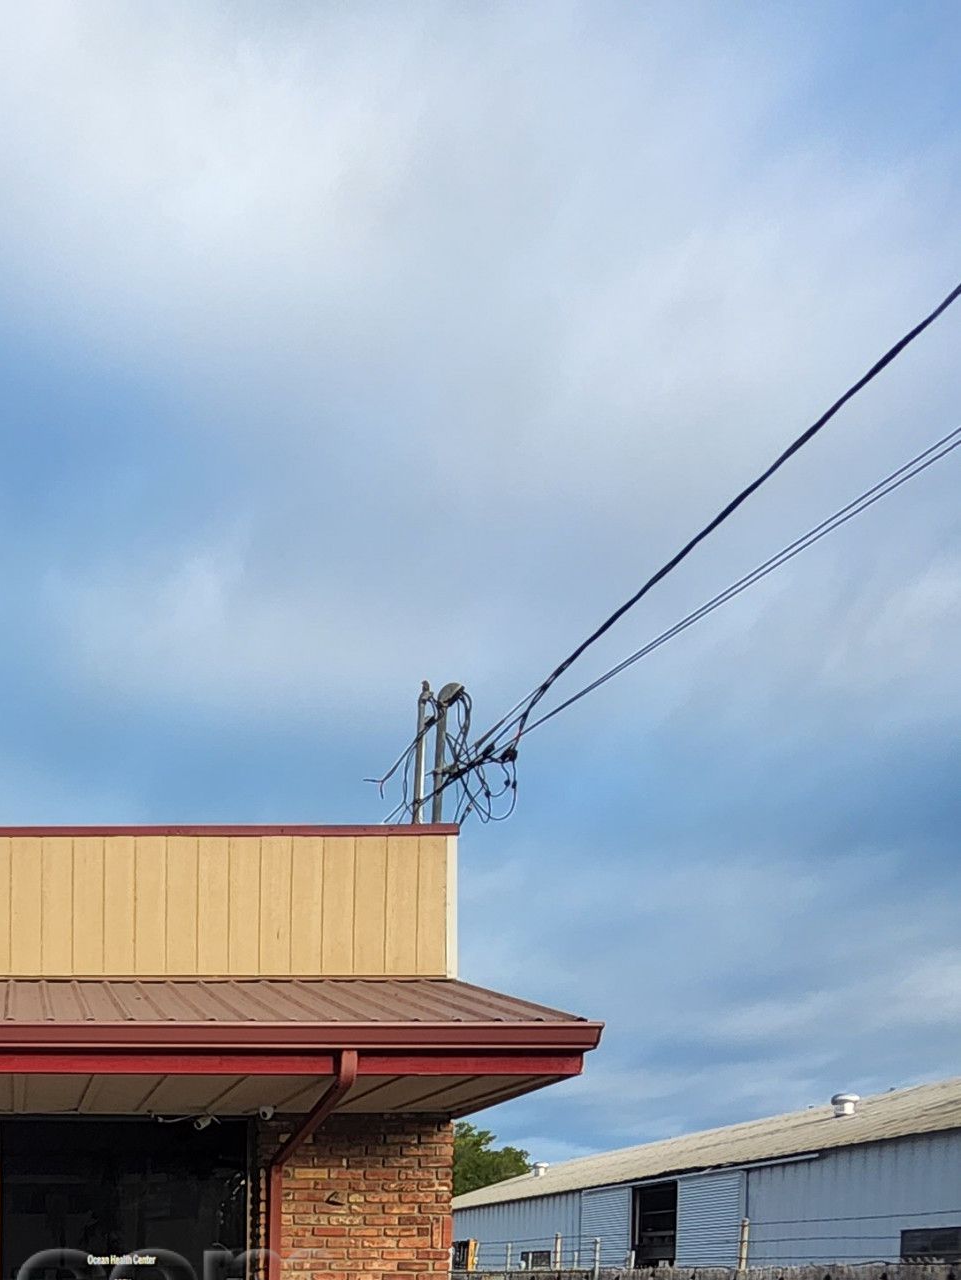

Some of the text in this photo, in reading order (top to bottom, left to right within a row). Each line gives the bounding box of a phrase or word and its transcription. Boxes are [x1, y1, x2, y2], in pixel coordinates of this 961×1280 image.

[87, 1254, 156, 1265] Ocean Health Center
